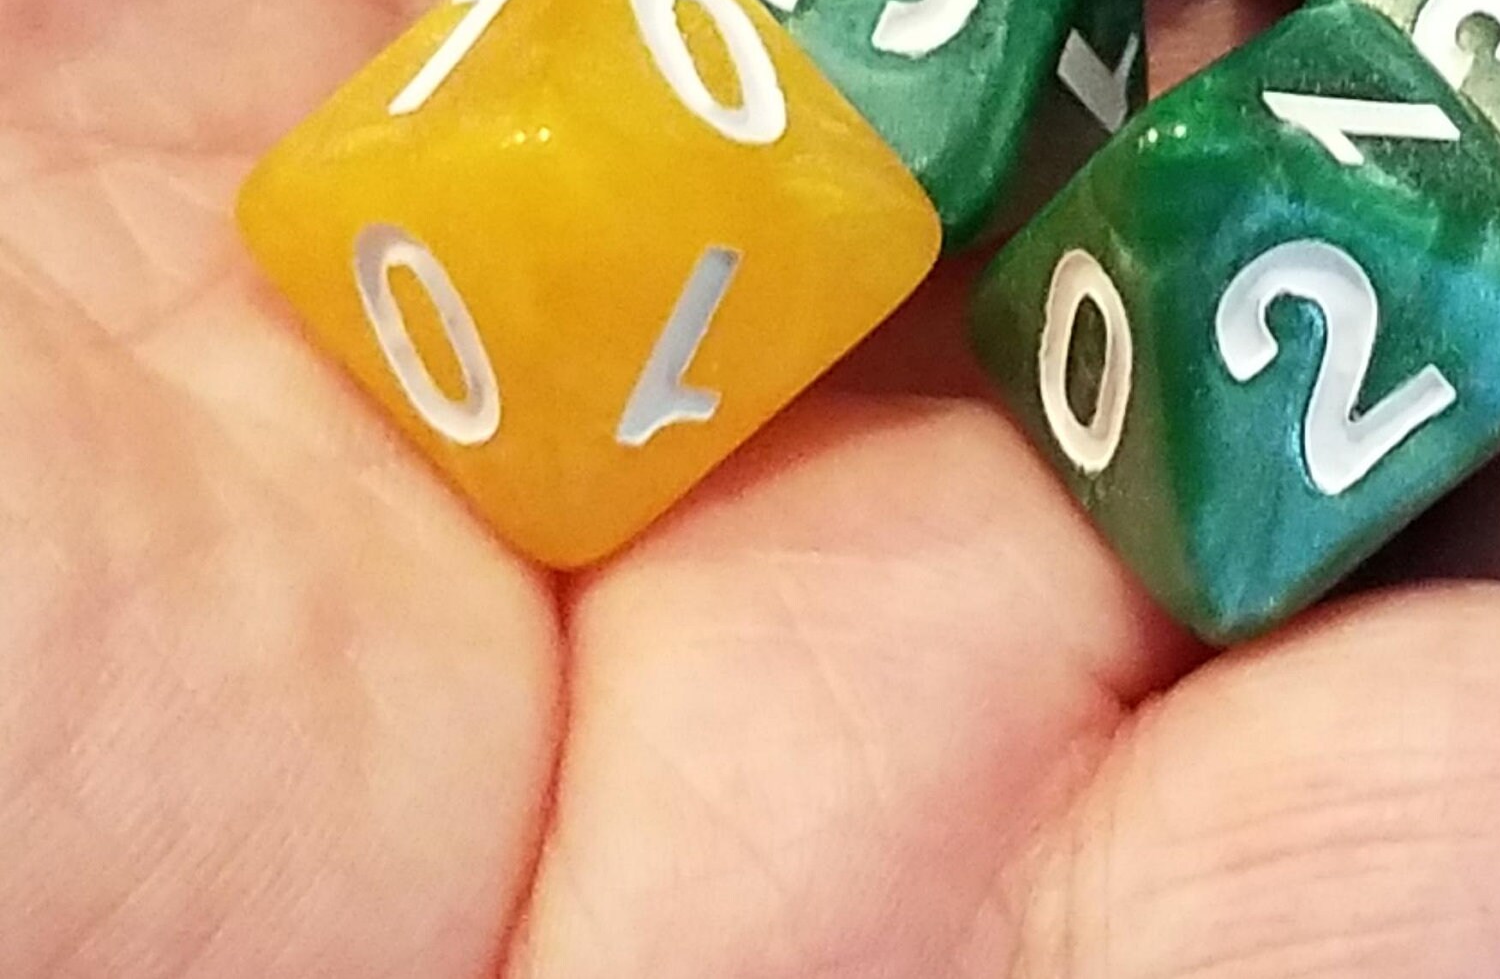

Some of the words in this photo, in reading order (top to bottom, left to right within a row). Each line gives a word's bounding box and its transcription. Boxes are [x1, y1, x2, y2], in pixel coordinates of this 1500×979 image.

[1262, 90, 1461, 165] 1
[353, 223, 501, 446] 0
[616, 245, 741, 447] 1
[1039, 248, 1133, 473] 0
[1216, 238, 1457, 496] 2
